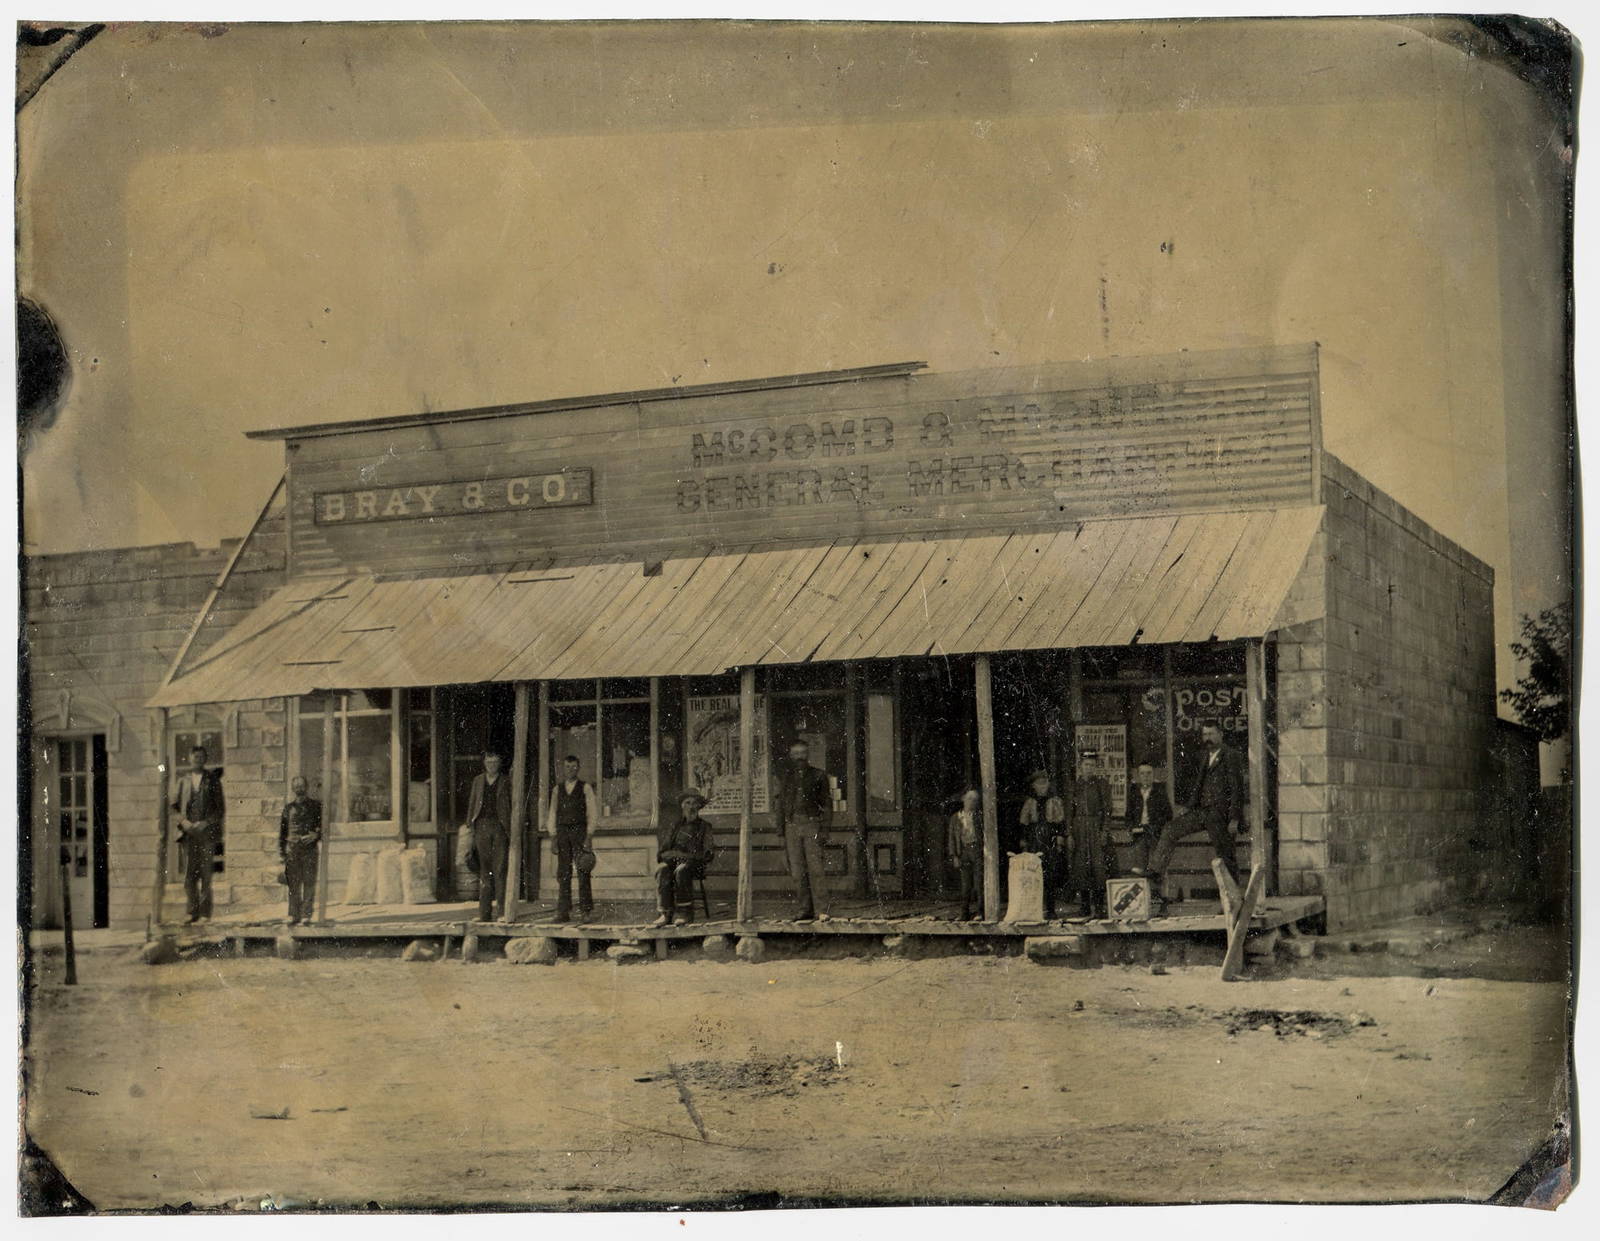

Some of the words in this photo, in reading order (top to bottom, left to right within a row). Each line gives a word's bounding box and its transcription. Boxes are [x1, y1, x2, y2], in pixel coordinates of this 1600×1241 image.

[322, 485, 443, 521] BRAY
[461, 482, 485, 509] &
[507, 473, 580, 506] CO.
[676, 465, 885, 514] GENERAL
[689, 699, 705, 713] THE
[1174, 687, 1248, 717] POST
